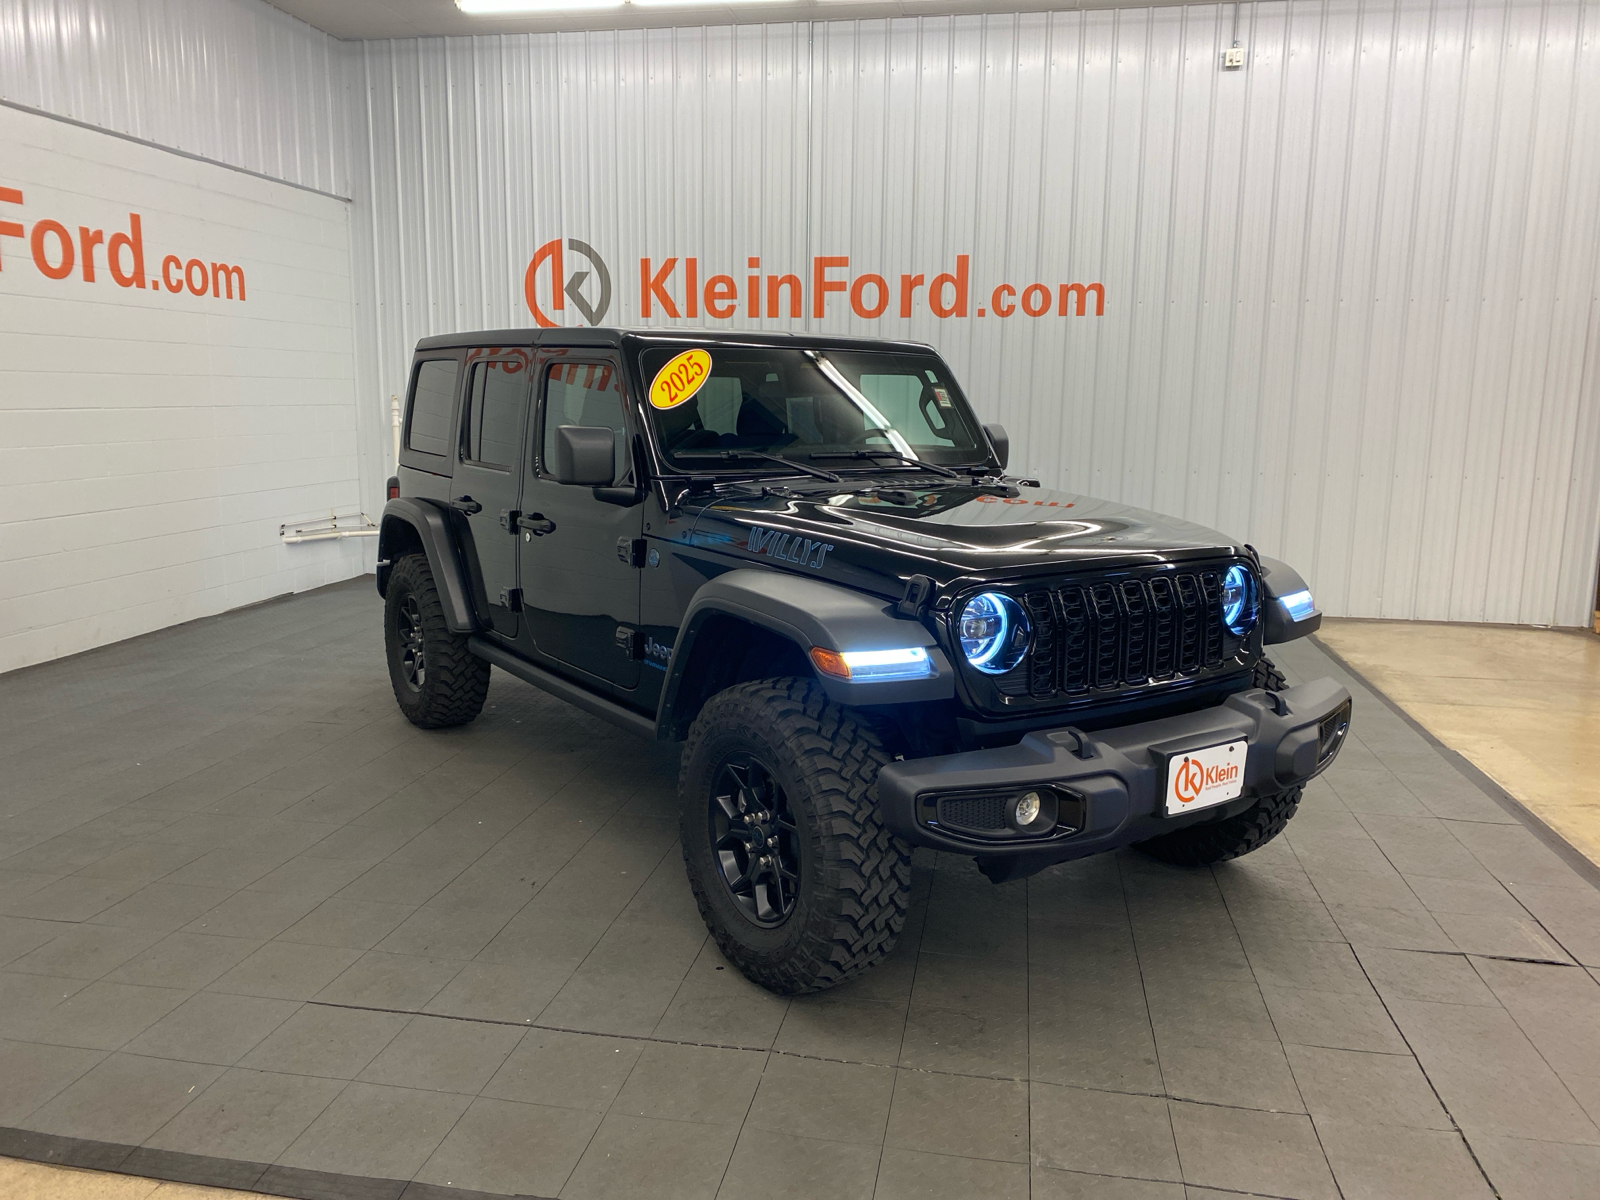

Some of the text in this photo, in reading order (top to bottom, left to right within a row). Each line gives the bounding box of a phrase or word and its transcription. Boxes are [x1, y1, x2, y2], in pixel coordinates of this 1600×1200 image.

[640, 254, 1105, 319] KleinFord.com
[660, 354, 704, 403] 2025
[747, 526, 835, 569] WILLYS
[1205, 762, 1239, 785] Klein
